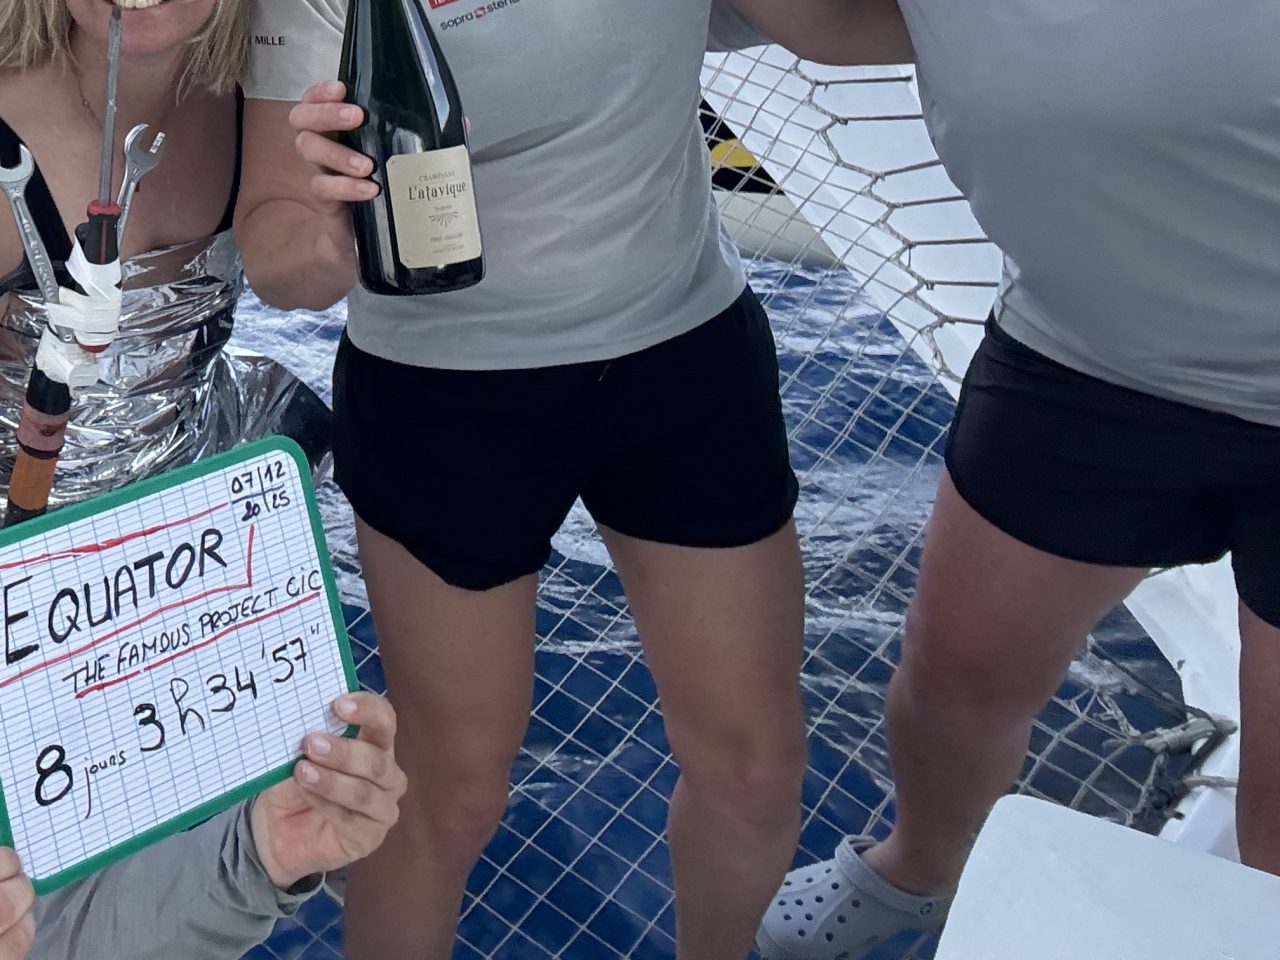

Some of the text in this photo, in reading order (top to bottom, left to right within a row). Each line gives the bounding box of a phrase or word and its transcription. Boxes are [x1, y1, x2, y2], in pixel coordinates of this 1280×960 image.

[254, 35, 286, 46] MILLE
[440, 11, 474, 31] sopra
[3, 528, 228, 665] EQUATOR
[62, 653, 110, 693] THE
[116, 622, 190, 674] FAMOUS
[198, 587, 279, 638] PROJECT
[34, 744, 74, 807] 8
